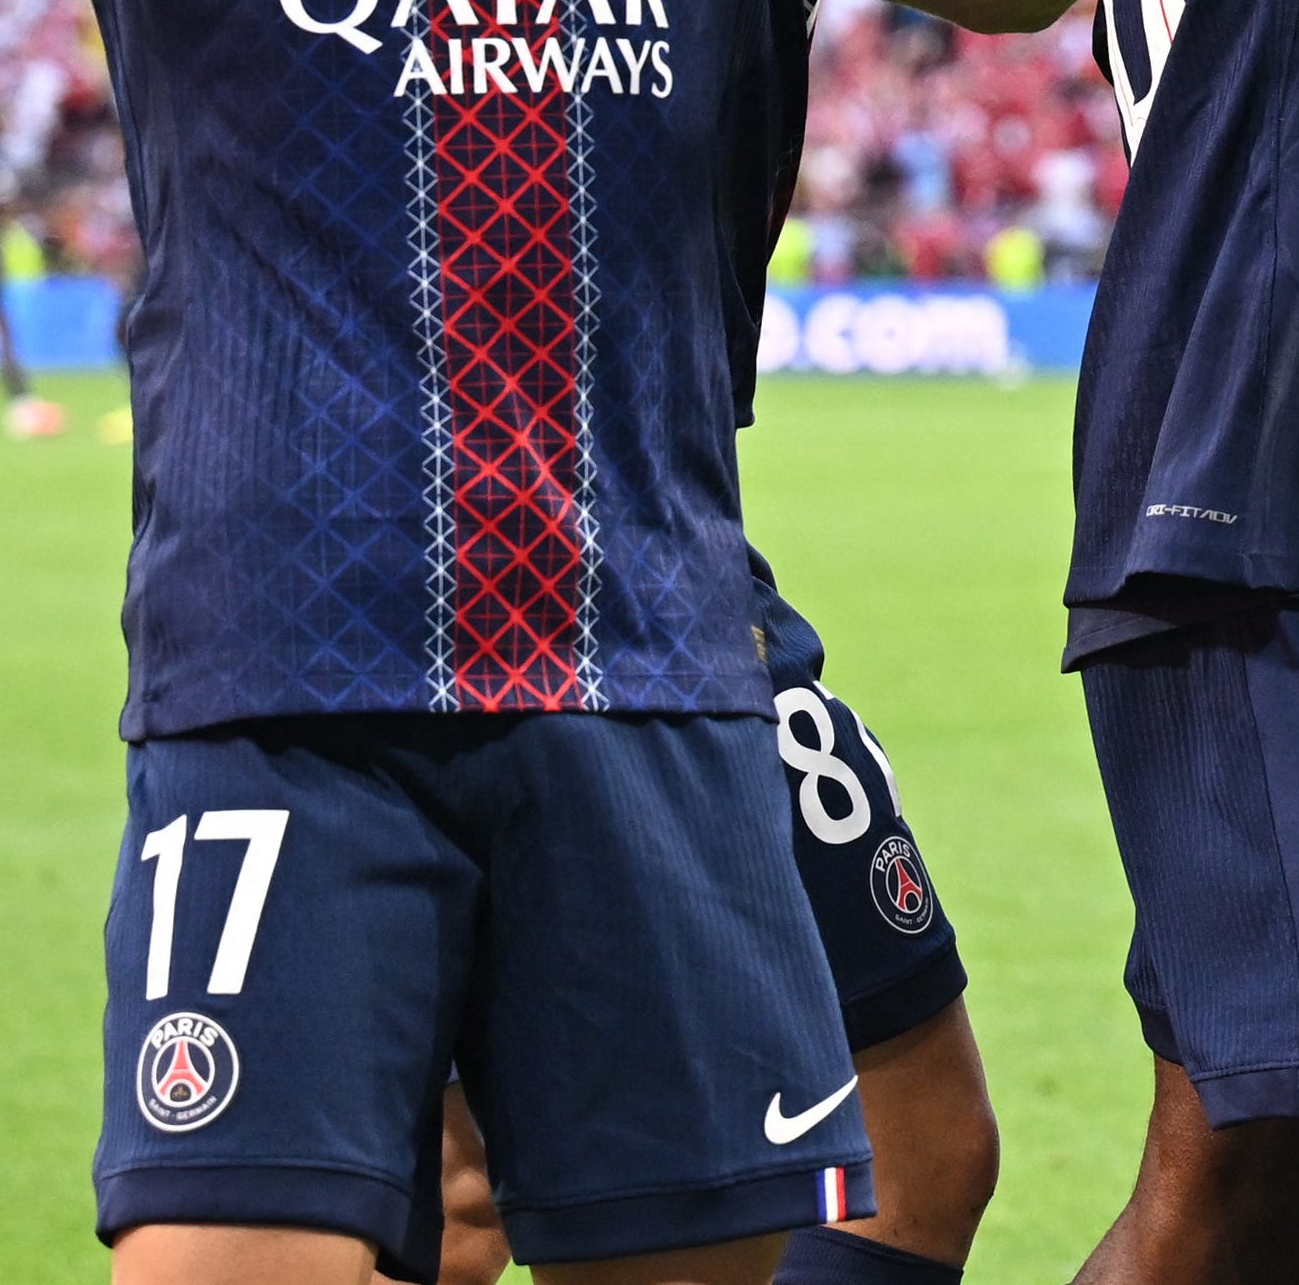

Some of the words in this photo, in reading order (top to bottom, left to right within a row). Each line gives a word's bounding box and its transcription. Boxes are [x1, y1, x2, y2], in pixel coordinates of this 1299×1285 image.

[393, 36, 673, 99] AIRWAYS
[875, 841, 911, 872] PARIS
[141, 809, 290, 1001] 17
[151, 1018, 219, 1050] PARIS
